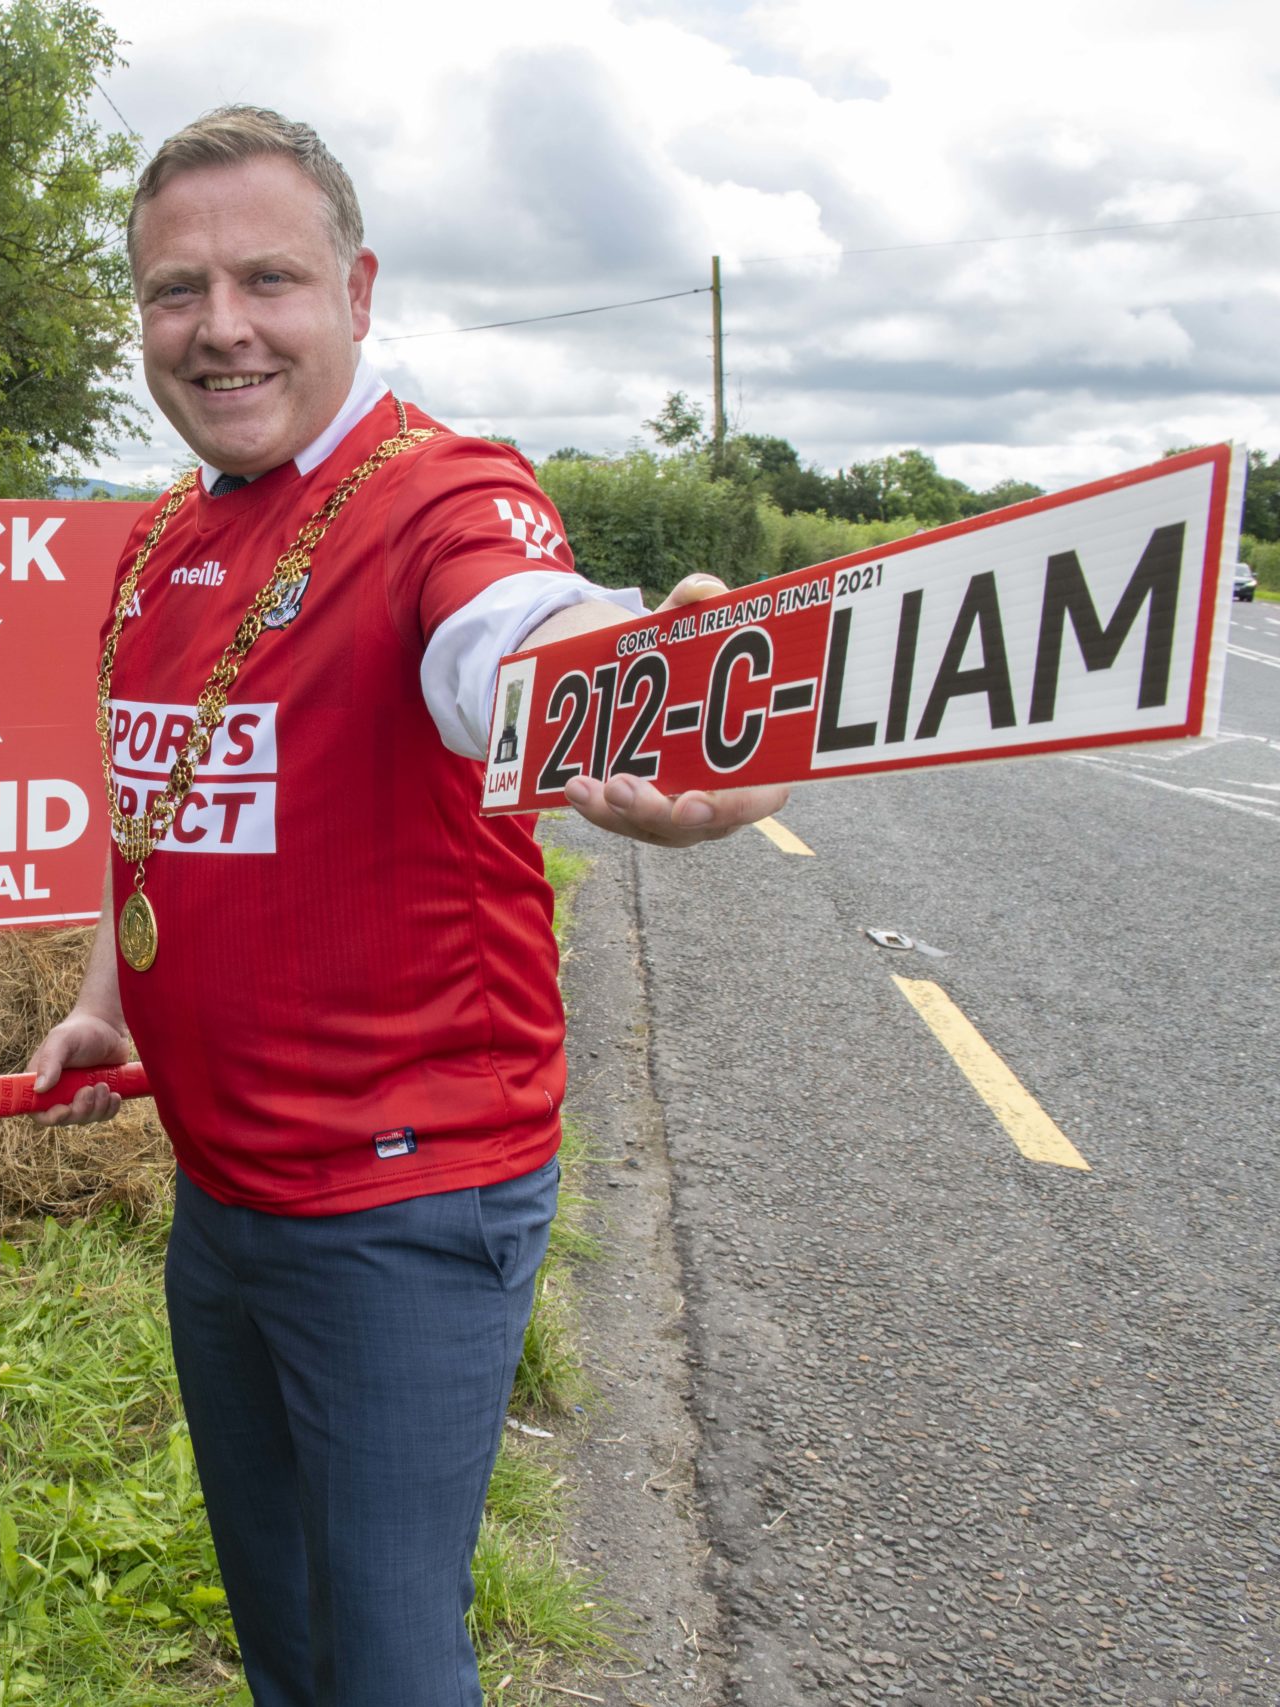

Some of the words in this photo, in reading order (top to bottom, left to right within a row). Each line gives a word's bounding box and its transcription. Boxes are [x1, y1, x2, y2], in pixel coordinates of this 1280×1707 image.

[617, 627, 659, 656] CORK
[668, 620, 697, 645] ALL
[699, 597, 772, 637] IRELAND
[775, 577, 831, 616] FINAL
[836, 564, 884, 598] 2021
[109, 706, 262, 767] PORTS
[488, 770, 518, 795] LIAM
